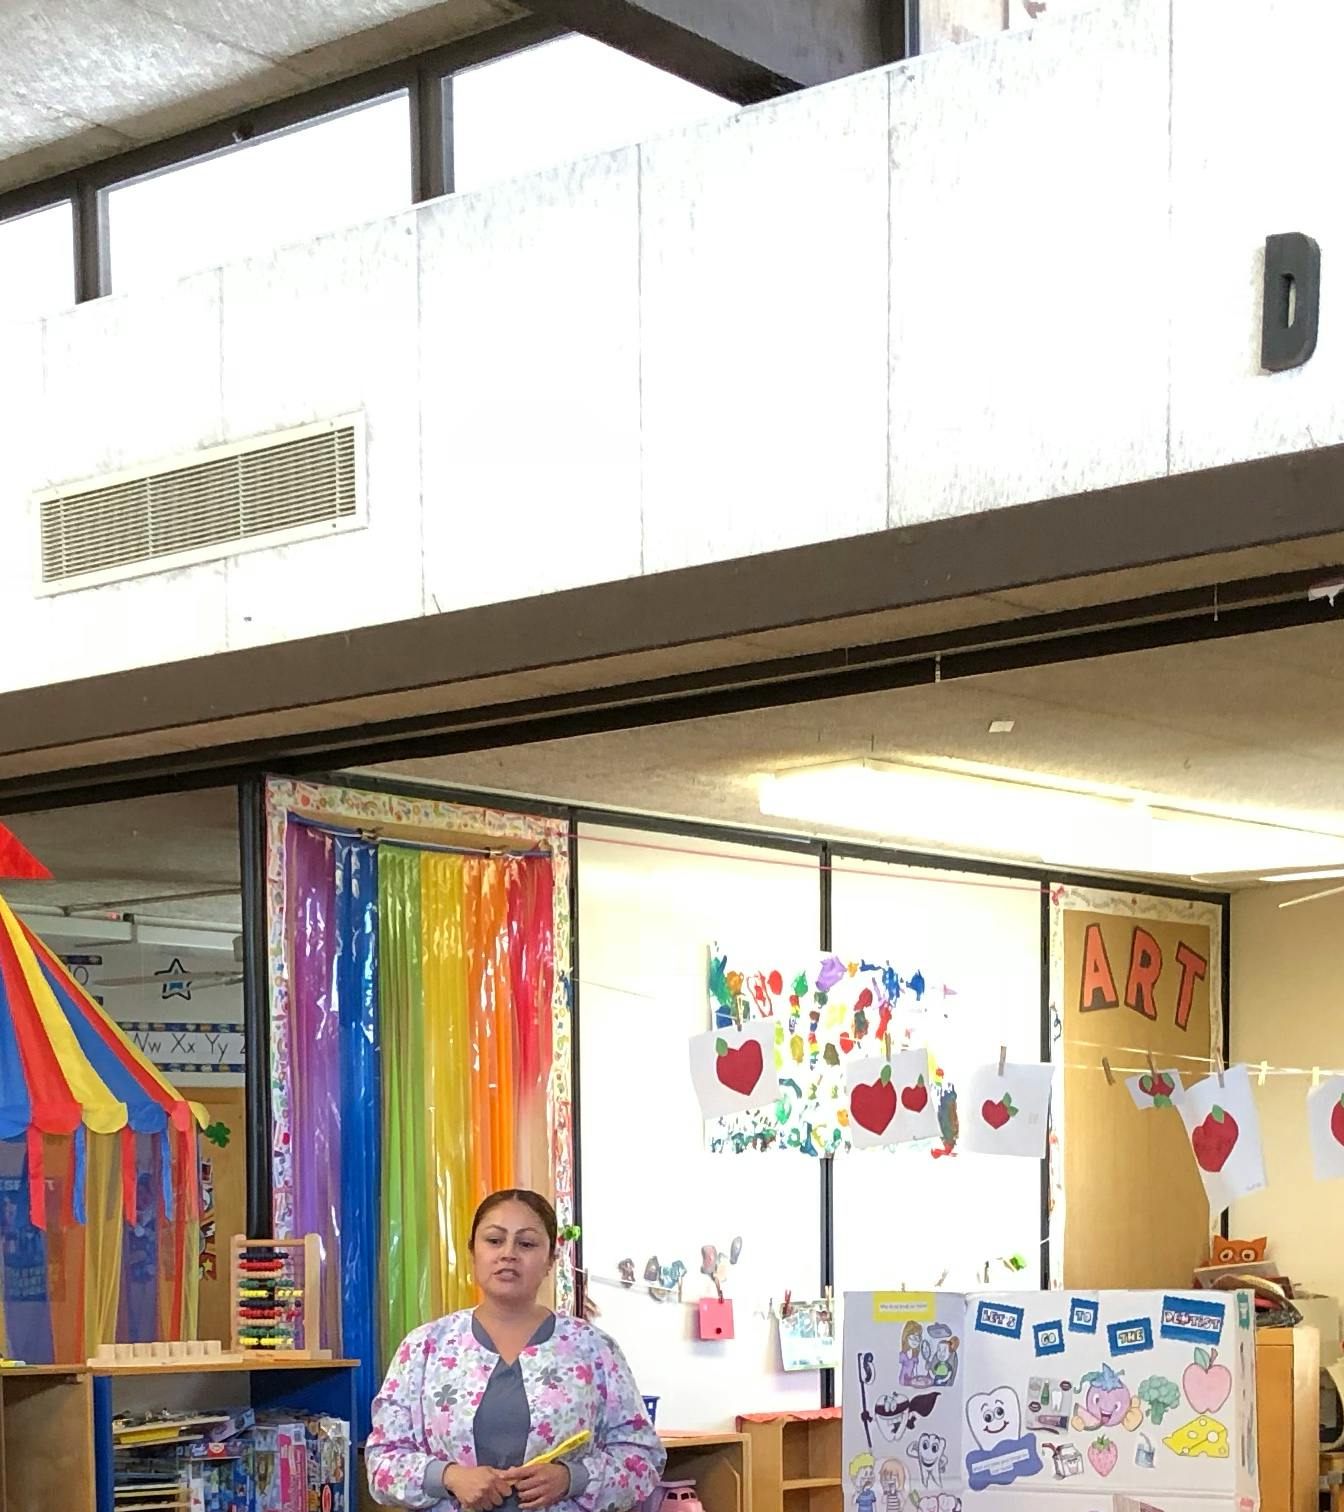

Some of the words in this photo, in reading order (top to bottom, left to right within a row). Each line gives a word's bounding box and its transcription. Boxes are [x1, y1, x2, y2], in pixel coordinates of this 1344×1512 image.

[1079, 923, 1208, 1032] ART
[171, 1033, 196, 1053] Xx
[205, 1034, 228, 1062] Yy
[1040, 1333, 1057, 1346] GO
[1075, 1311, 1092, 1323] TO
[1119, 1328, 1144, 1344] THE
[1164, 1311, 1221, 1330] DENTIST
